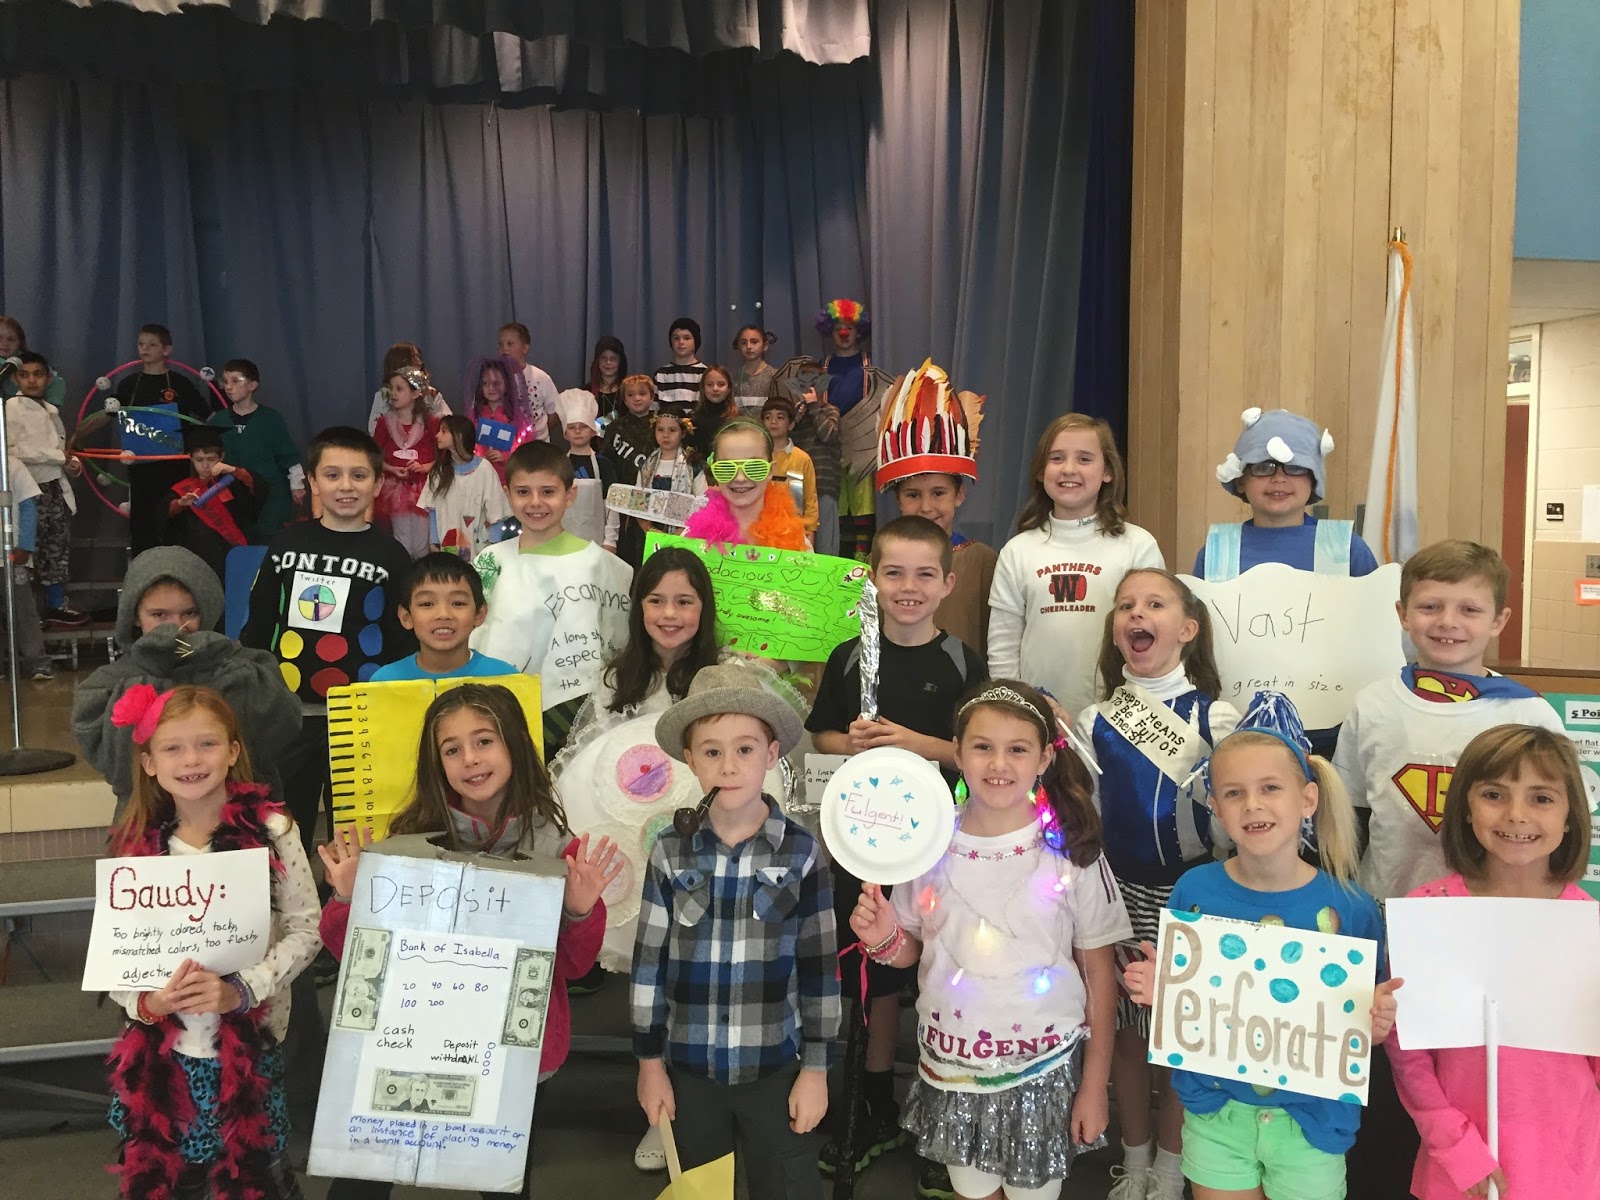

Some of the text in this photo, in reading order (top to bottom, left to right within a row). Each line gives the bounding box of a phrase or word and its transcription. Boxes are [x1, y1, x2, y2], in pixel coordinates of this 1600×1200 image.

[1036, 563, 1102, 578] PANTHERS
[300, 574, 336, 585] Twister
[1051, 574, 1080, 602] W
[1040, 605, 1096, 614] CHEERLEADER
[1211, 592, 1324, 644] Vast
[551, 638, 560, 650] A
[564, 632, 588, 644] long
[560, 678, 581, 690] the
[1233, 674, 1344, 697] great in size
[110, 866, 226, 922] Gaudy:
[112, 927, 128, 940] Too
[134, 928, 164, 942] brightly
[112, 945, 161, 956] mismatched
[206, 937, 220, 947] too
[400, 940, 500, 960] Bank of Isabella
[122, 964, 172, 982] adjective
[474, 983, 488, 992] 80
[400, 998, 416, 1008] 100
[1154, 922, 1369, 1086] Perforate
[384, 1024, 414, 1034] cash
[376, 1038, 413, 1049] check
[444, 1040, 478, 1052] Deposit
[350, 1116, 384, 1128] Money
[390, 1119, 416, 1129] placed
[371, 1126, 414, 1138] instance
[424, 1132, 436, 1140] of
[442, 1134, 480, 1148] placing
[487, 1140, 516, 1153] money
